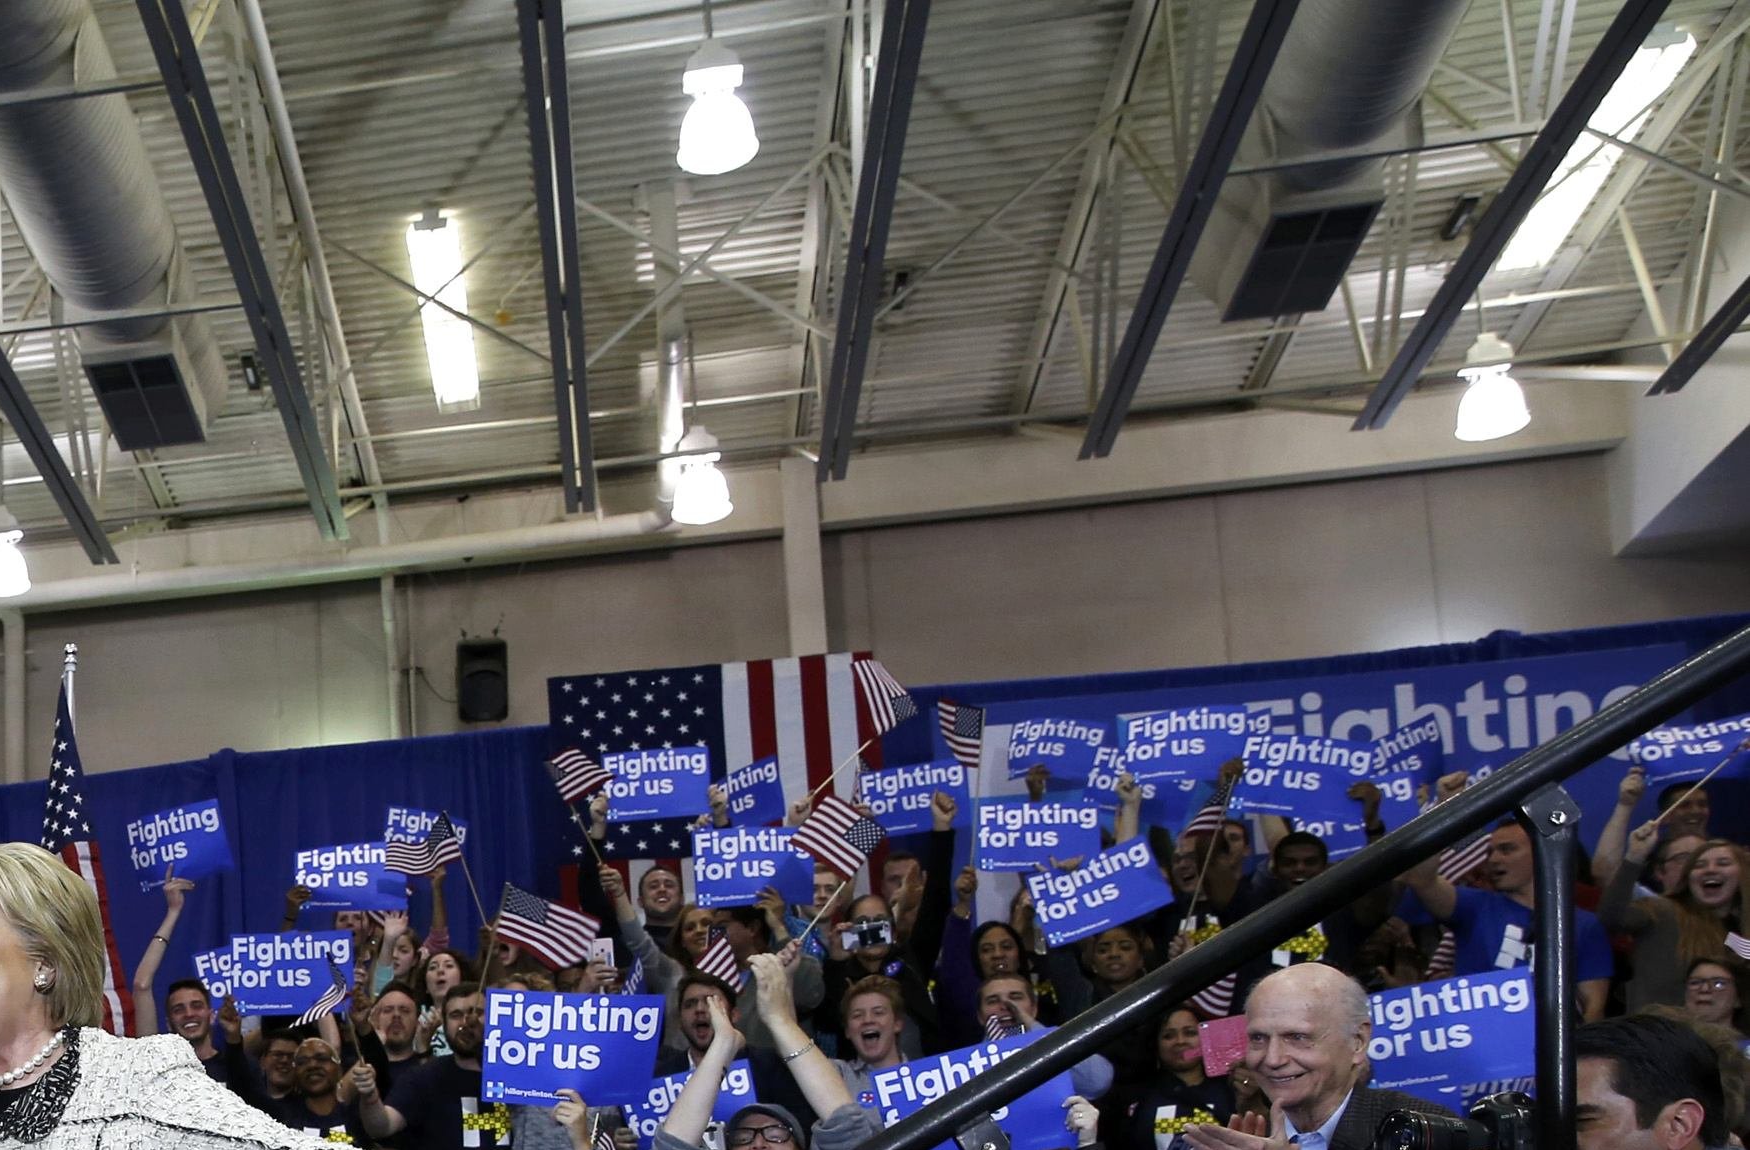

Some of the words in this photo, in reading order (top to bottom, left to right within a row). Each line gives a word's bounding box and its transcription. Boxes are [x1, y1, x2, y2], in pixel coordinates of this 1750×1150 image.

[1012, 719, 1105, 746] Fighting
[1128, 707, 1246, 740] Fighting
[1645, 716, 1750, 745] ighting
[1008, 741, 1035, 760] for
[1036, 741, 1065, 757] us
[1125, 740, 1167, 763] for
[1170, 737, 1206, 757] us
[1242, 735, 1374, 777] Fighting
[1371, 720, 1439, 770] ghting
[1630, 741, 1677, 764] for
[1681, 740, 1724, 756] us
[603, 750, 707, 780] Fighting
[718, 761, 778, 798] ghting
[860, 764, 964, 795] Fighting
[1282, 769, 1321, 791] us
[603, 777, 641, 799] for
[643, 777, 674, 795] us
[901, 791, 931, 811] us
[731, 793, 755, 814] us
[979, 803, 1098, 830] Fighting
[127, 806, 220, 846] Fighting
[978, 828, 1021, 849] for
[1025, 830, 1058, 848] us
[131, 847, 161, 870] for
[161, 840, 188, 861] us
[297, 843, 386, 871] Fightin
[694, 858, 737, 882] for
[742, 859, 776, 878] us
[295, 870, 333, 889] for
[338, 870, 369, 887] us
[1028, 842, 1150, 900] Fighting
[1035, 897, 1079, 923] for
[1081, 882, 1120, 908] us
[232, 934, 350, 968] Fighting
[230, 962, 272, 988] for
[277, 967, 312, 988] us
[489, 992, 660, 1042] Fighting
[1367, 978, 1530, 1031] ighting
[484, 1029, 547, 1067] for
[553, 1043, 602, 1071] us
[1366, 1032, 1413, 1061] or
[1420, 1024, 1473, 1053] us
[874, 1043, 1024, 1121] Fighti
